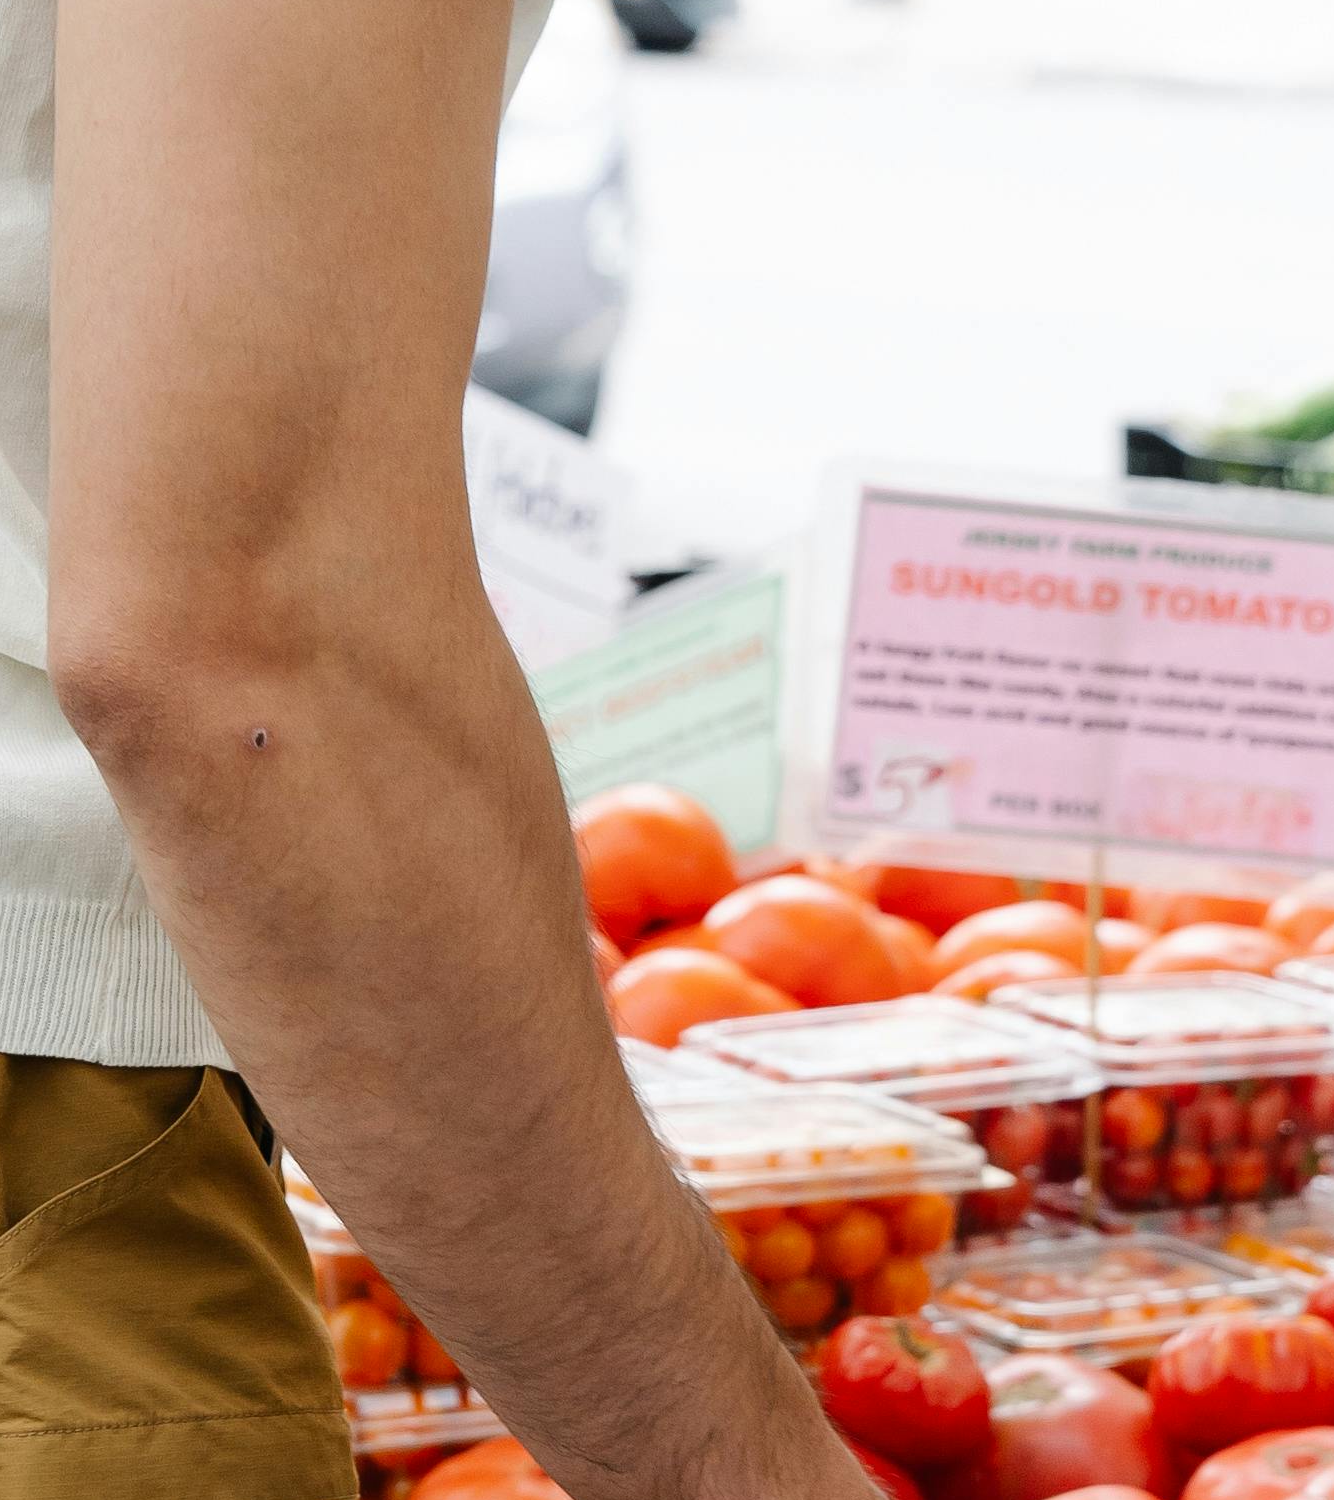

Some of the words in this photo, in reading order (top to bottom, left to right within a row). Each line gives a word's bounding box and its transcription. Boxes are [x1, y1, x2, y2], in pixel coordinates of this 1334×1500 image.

[892, 559, 1120, 614] SUNGOLD
[1139, 584, 1334, 634] TOMATO
[836, 765, 863, 798] $
